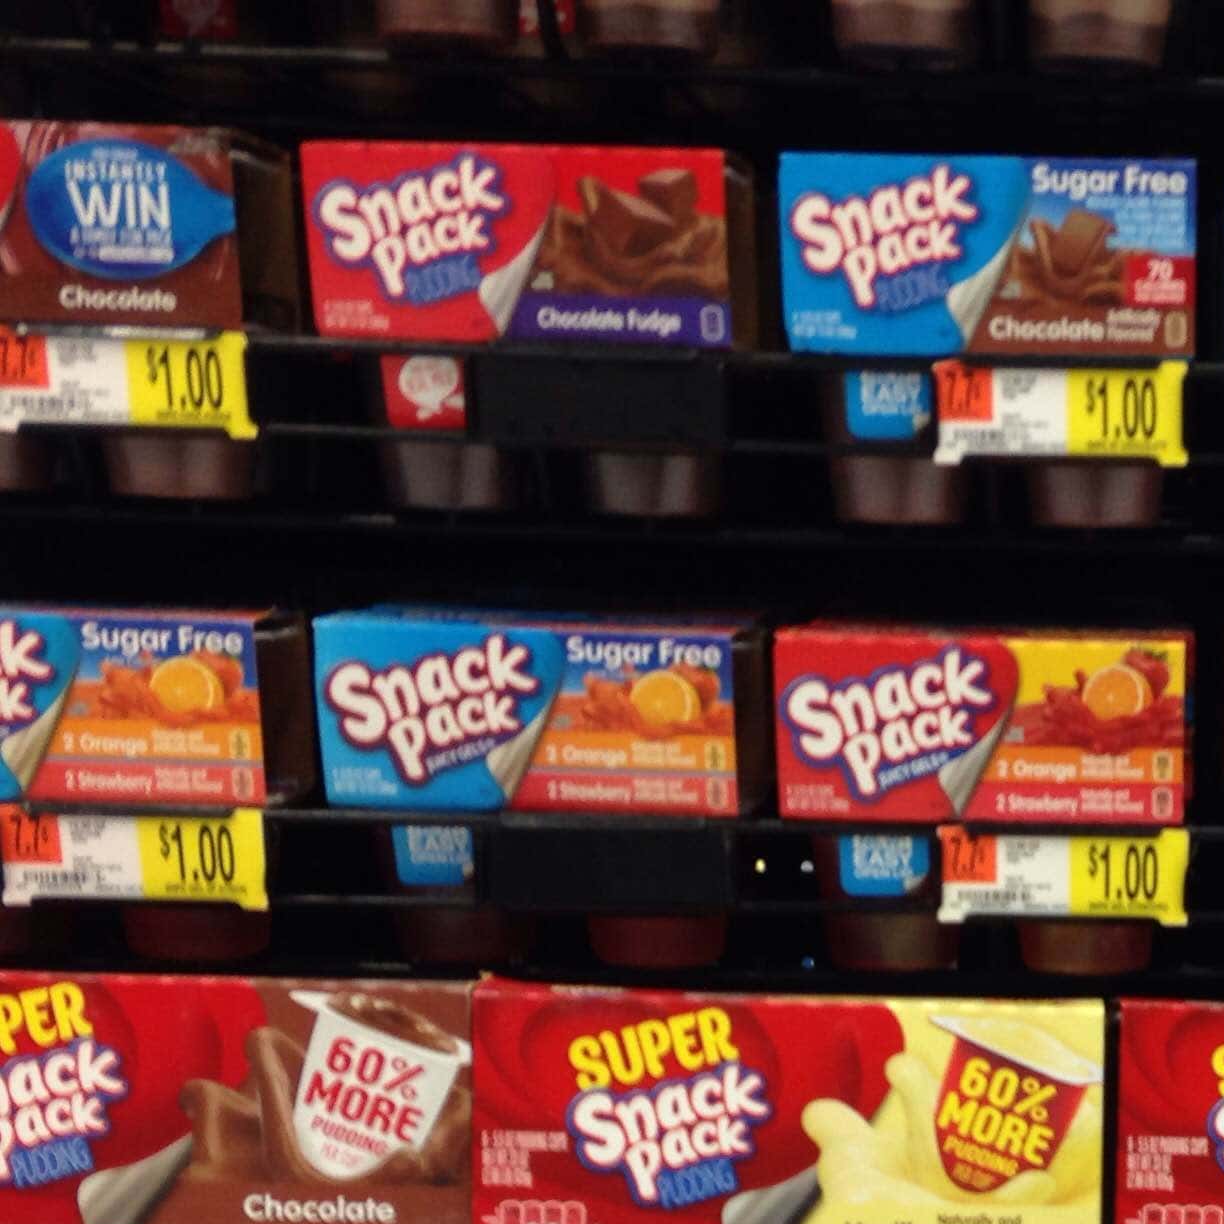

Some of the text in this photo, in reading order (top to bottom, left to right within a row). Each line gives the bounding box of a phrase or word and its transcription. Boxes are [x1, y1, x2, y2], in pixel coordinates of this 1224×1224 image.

[69, 182, 171, 227] WIN
[319, 158, 504, 261] Snack
[1032, 163, 1187, 199] Sugar Free
[792, 165, 976, 270] Snack
[59, 285, 176, 311] Chocolate
[989, 315, 1104, 340] Chocolate
[147, 347, 222, 407] $1.00
[1086, 378, 1156, 438] $1.00
[81, 624, 171, 656] Sugar
[180, 627, 243, 656] Free
[567, 637, 721, 667] Sugar Free
[330, 636, 537, 742] Snack
[789, 650, 990, 758] Snack
[160, 823, 234, 883] $1.00
[1089, 844, 1157, 900] $1.00
[0, 1039, 123, 1108] ack
[327, 1037, 424, 1099] 60%
[569, 1008, 738, 1088] SUPER
[306, 1072, 423, 1142] MORE
[573, 1066, 768, 1165] Snack
[960, 1058, 1056, 1121] 60%
[938, 1097, 1054, 1162] MORE
[244, 1194, 396, 1222] Chocolate
